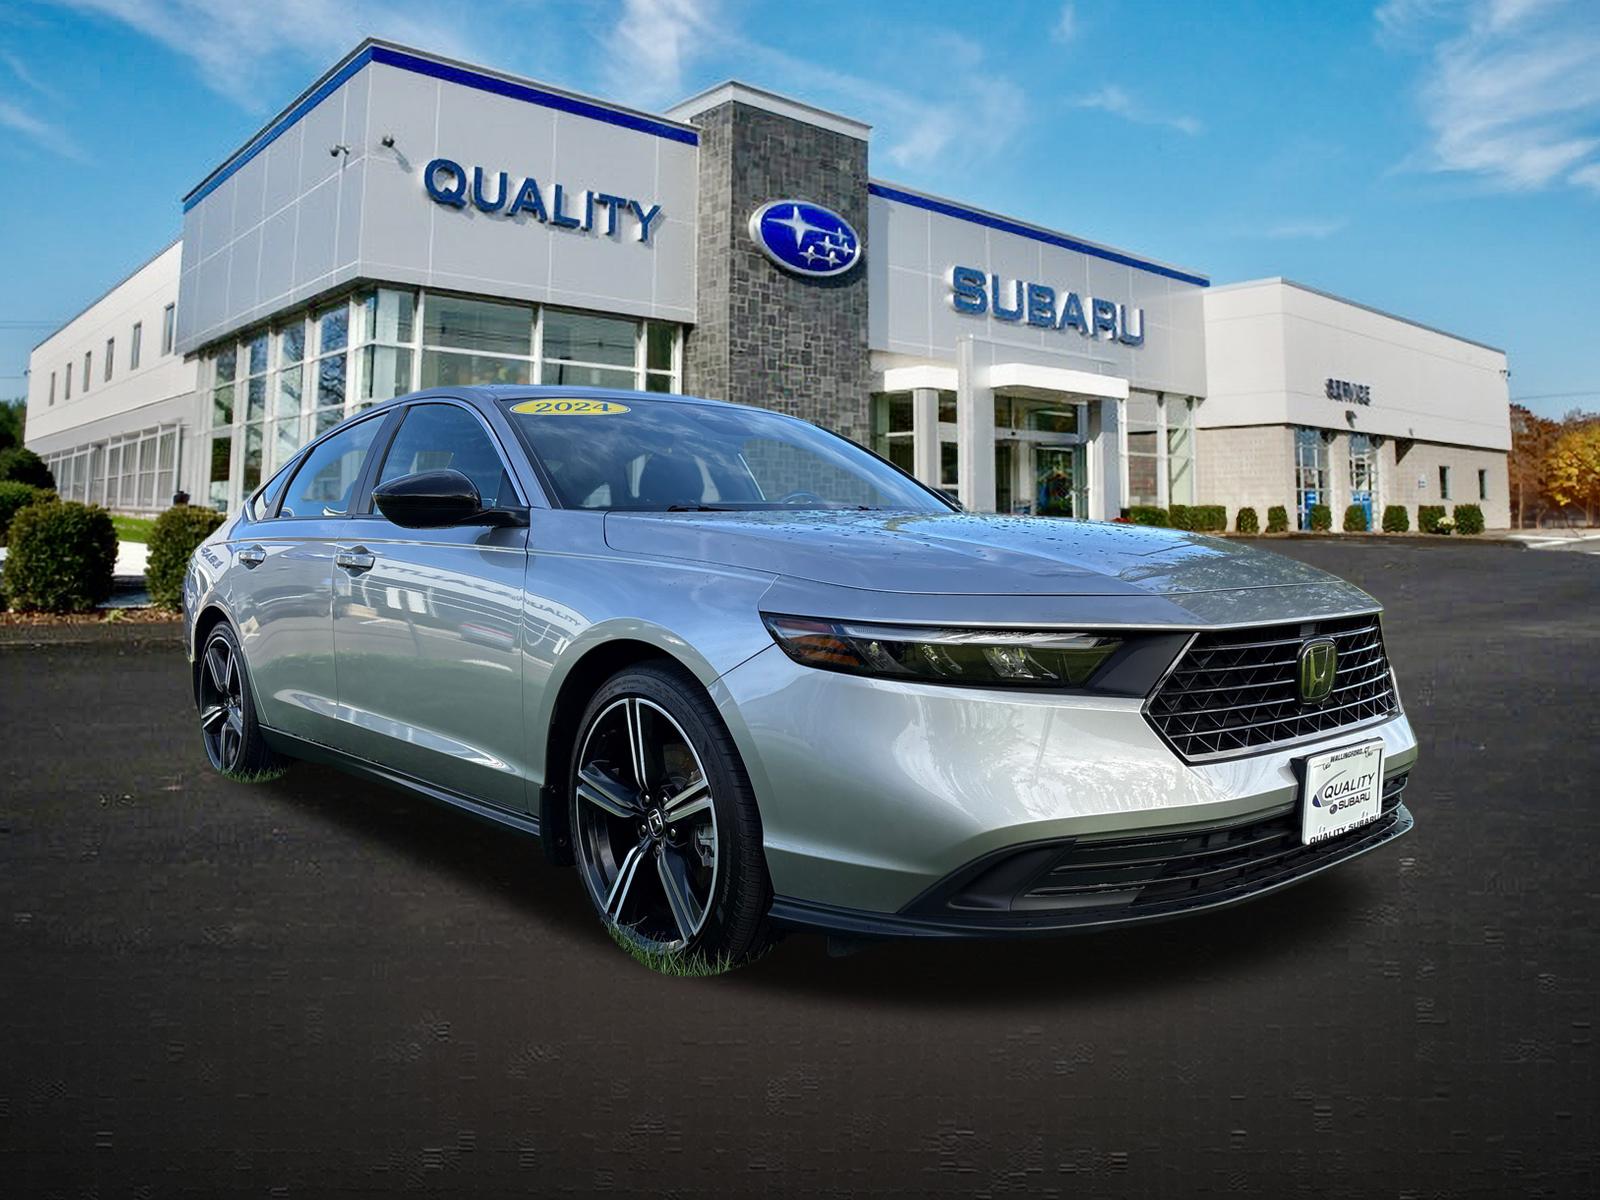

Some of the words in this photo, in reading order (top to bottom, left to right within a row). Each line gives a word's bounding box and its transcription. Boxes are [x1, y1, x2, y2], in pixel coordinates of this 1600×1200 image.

[424, 158, 661, 243] QUALITY
[949, 265, 1145, 347] SUBARU
[535, 402, 610, 412] 2024
[1324, 772, 1375, 799] QUALITY
[1338, 791, 1371, 810] SUBARU
[1309, 826, 1346, 844] QUALITY
[1348, 813, 1381, 830] SUBARU
